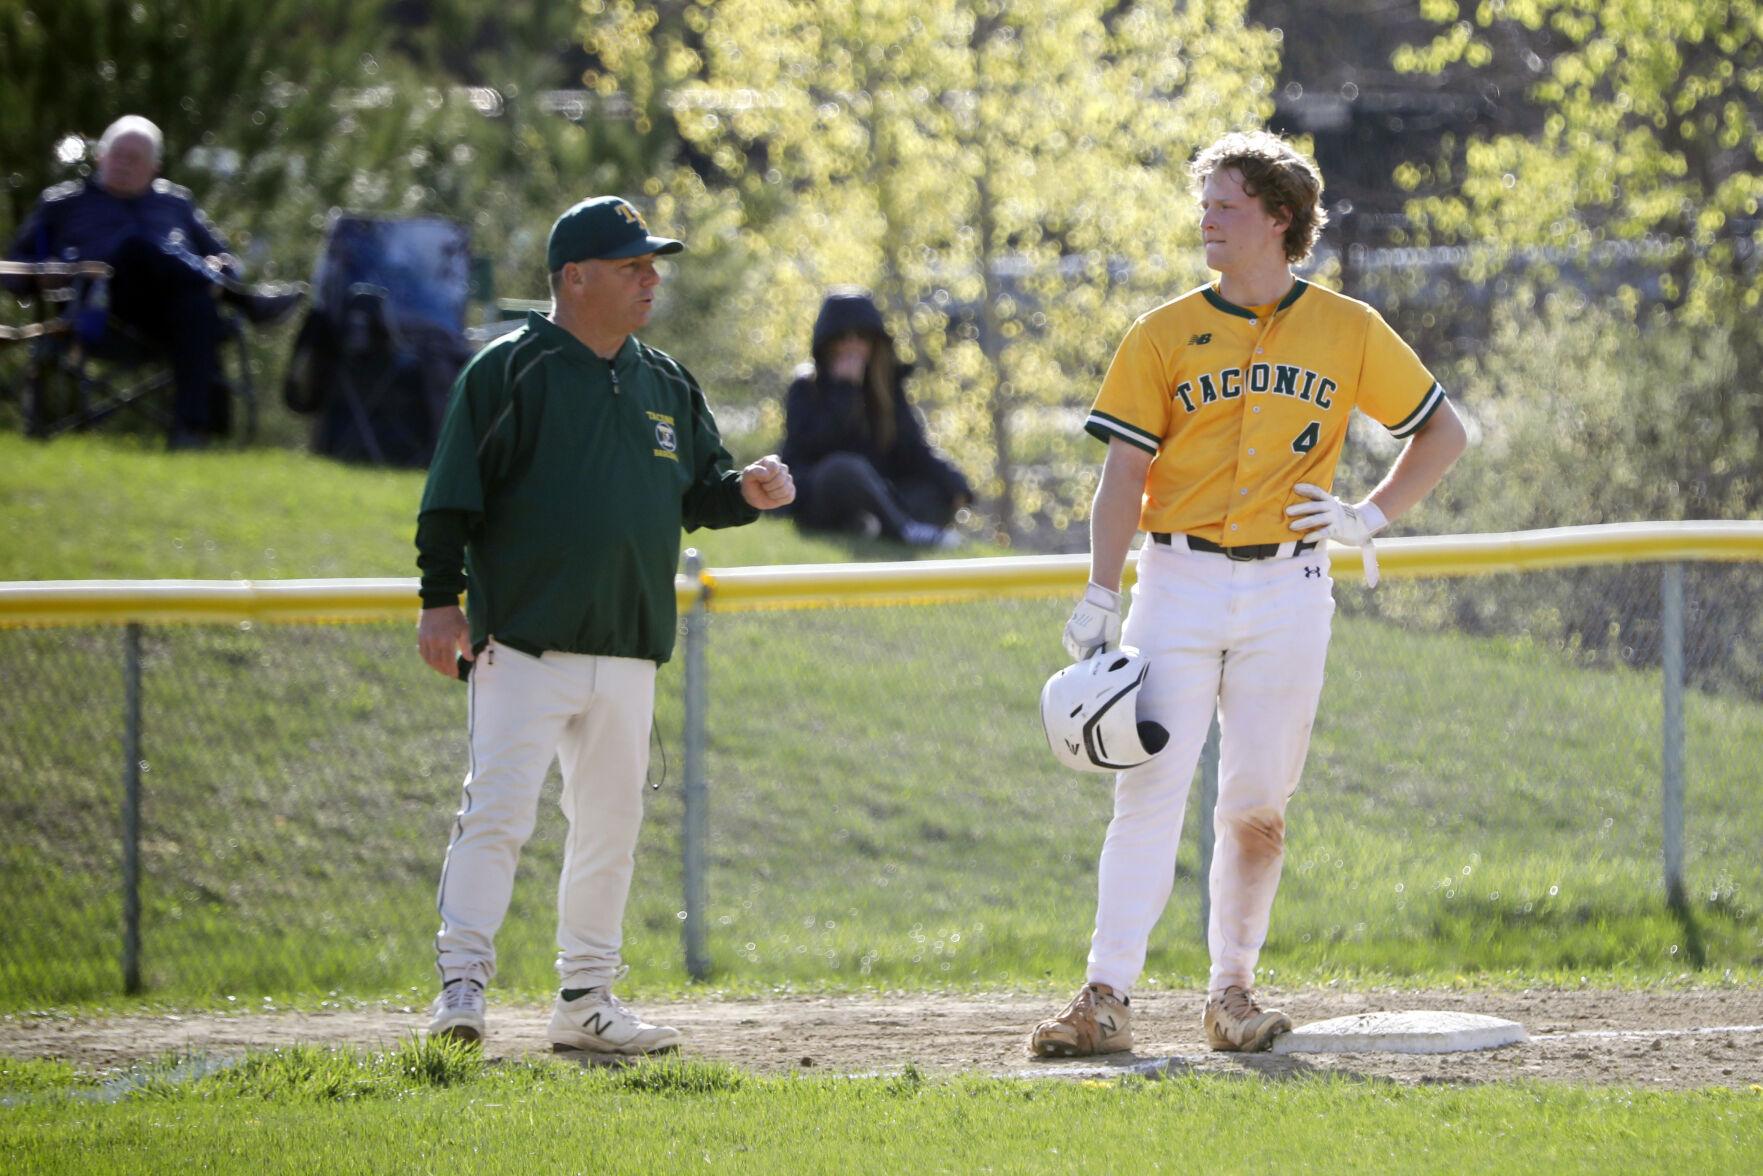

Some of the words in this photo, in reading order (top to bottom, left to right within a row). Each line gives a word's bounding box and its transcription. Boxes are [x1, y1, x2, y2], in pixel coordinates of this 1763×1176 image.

[1174, 363, 1337, 412] TACONIC
[1292, 420, 1321, 454] 4
[583, 1012, 613, 1035] N
